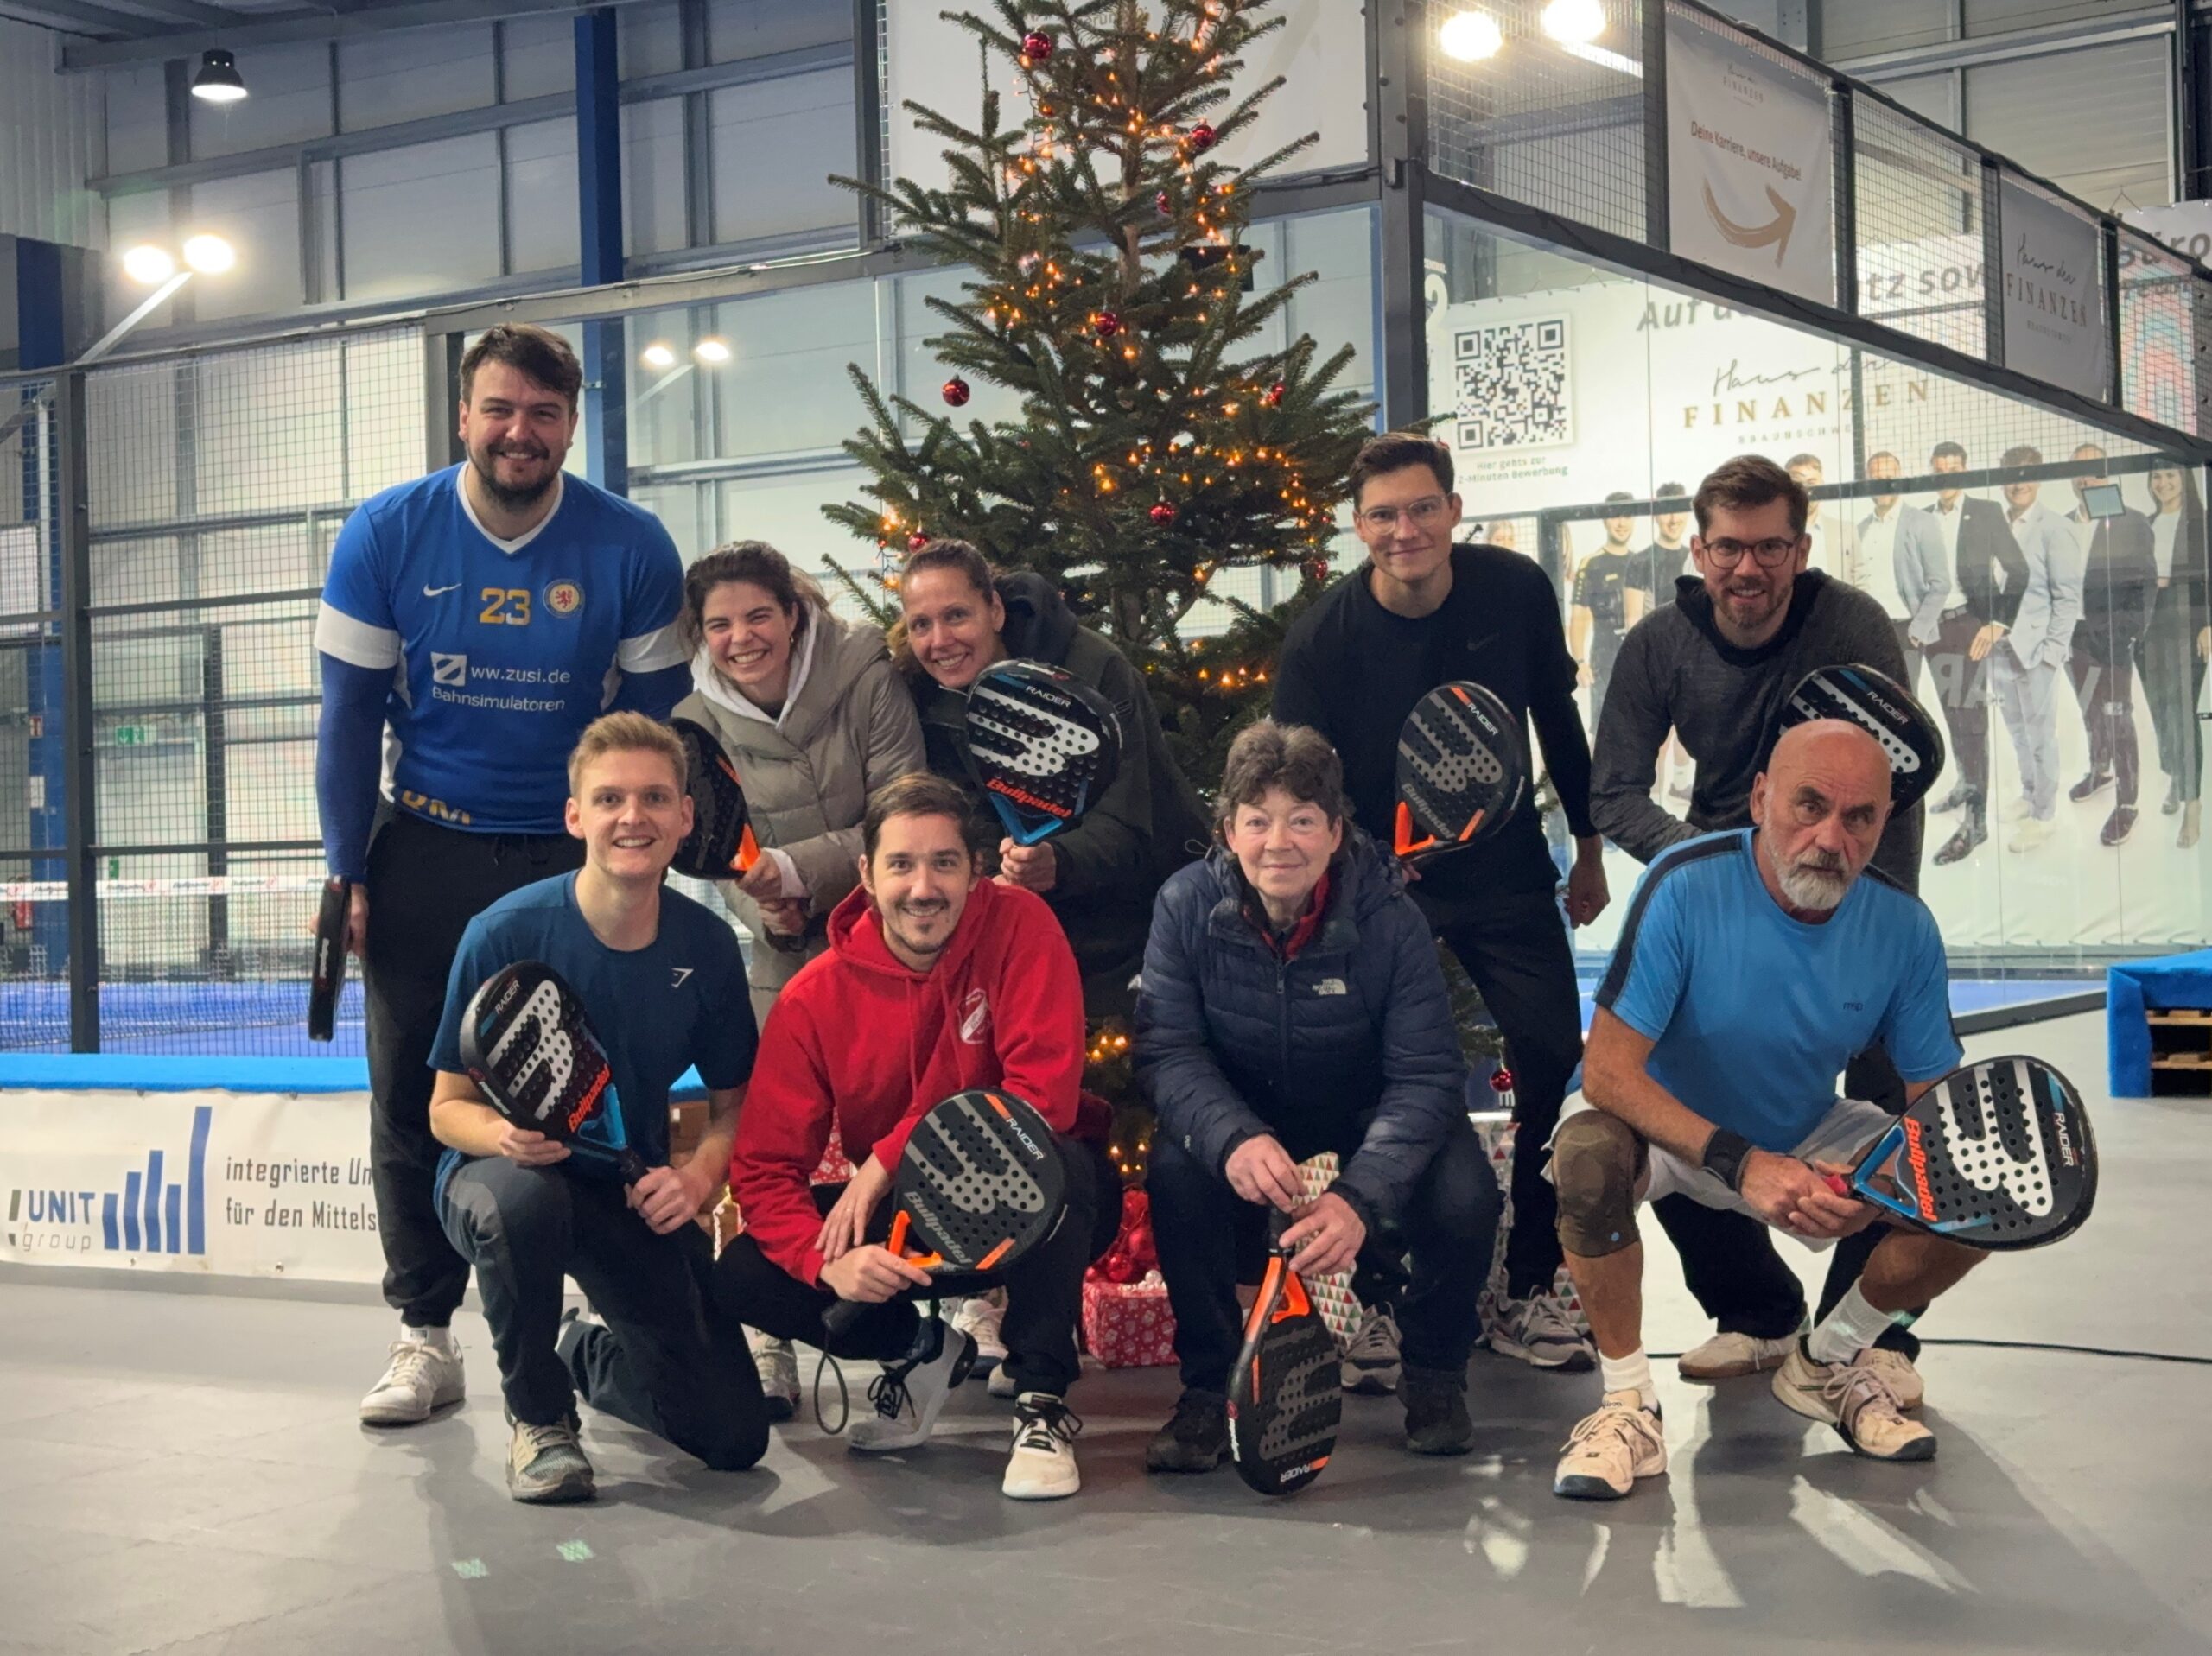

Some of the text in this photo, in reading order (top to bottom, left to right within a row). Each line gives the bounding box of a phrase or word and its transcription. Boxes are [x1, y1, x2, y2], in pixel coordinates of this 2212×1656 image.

[1691, 121, 1713, 144] Deine
[2006, 272, 2088, 328] FINANZEN
[1683, 379, 1929, 429] FINANZEN
[479, 587, 531, 626] 23
[432, 687, 565, 712] Bahnsimulatoren
[1026, 685, 1071, 708] RAIDER
[1867, 690, 1909, 726] RAIDER
[1469, 702, 1498, 735] RAIDER
[986, 778, 1074, 819] Bullpadel
[1401, 783, 1457, 840] Bullpadel
[494, 980, 520, 1015] RAIDER
[568, 1063, 612, 1133] Bullpadel
[1006, 1117, 1044, 1161] RAIDER
[2054, 1111, 2074, 1167] RAIDER
[226, 1156, 340, 1188] integrierte
[1904, 1116, 1938, 1222] Bullpadel
[28, 1190, 95, 1224] UNIT
[226, 1197, 378, 1232] für den Mittels
[22, 1232, 92, 1253] group
[904, 1191, 973, 1266] Bullpadel
[1280, 1462, 1311, 1483] RAIDER
